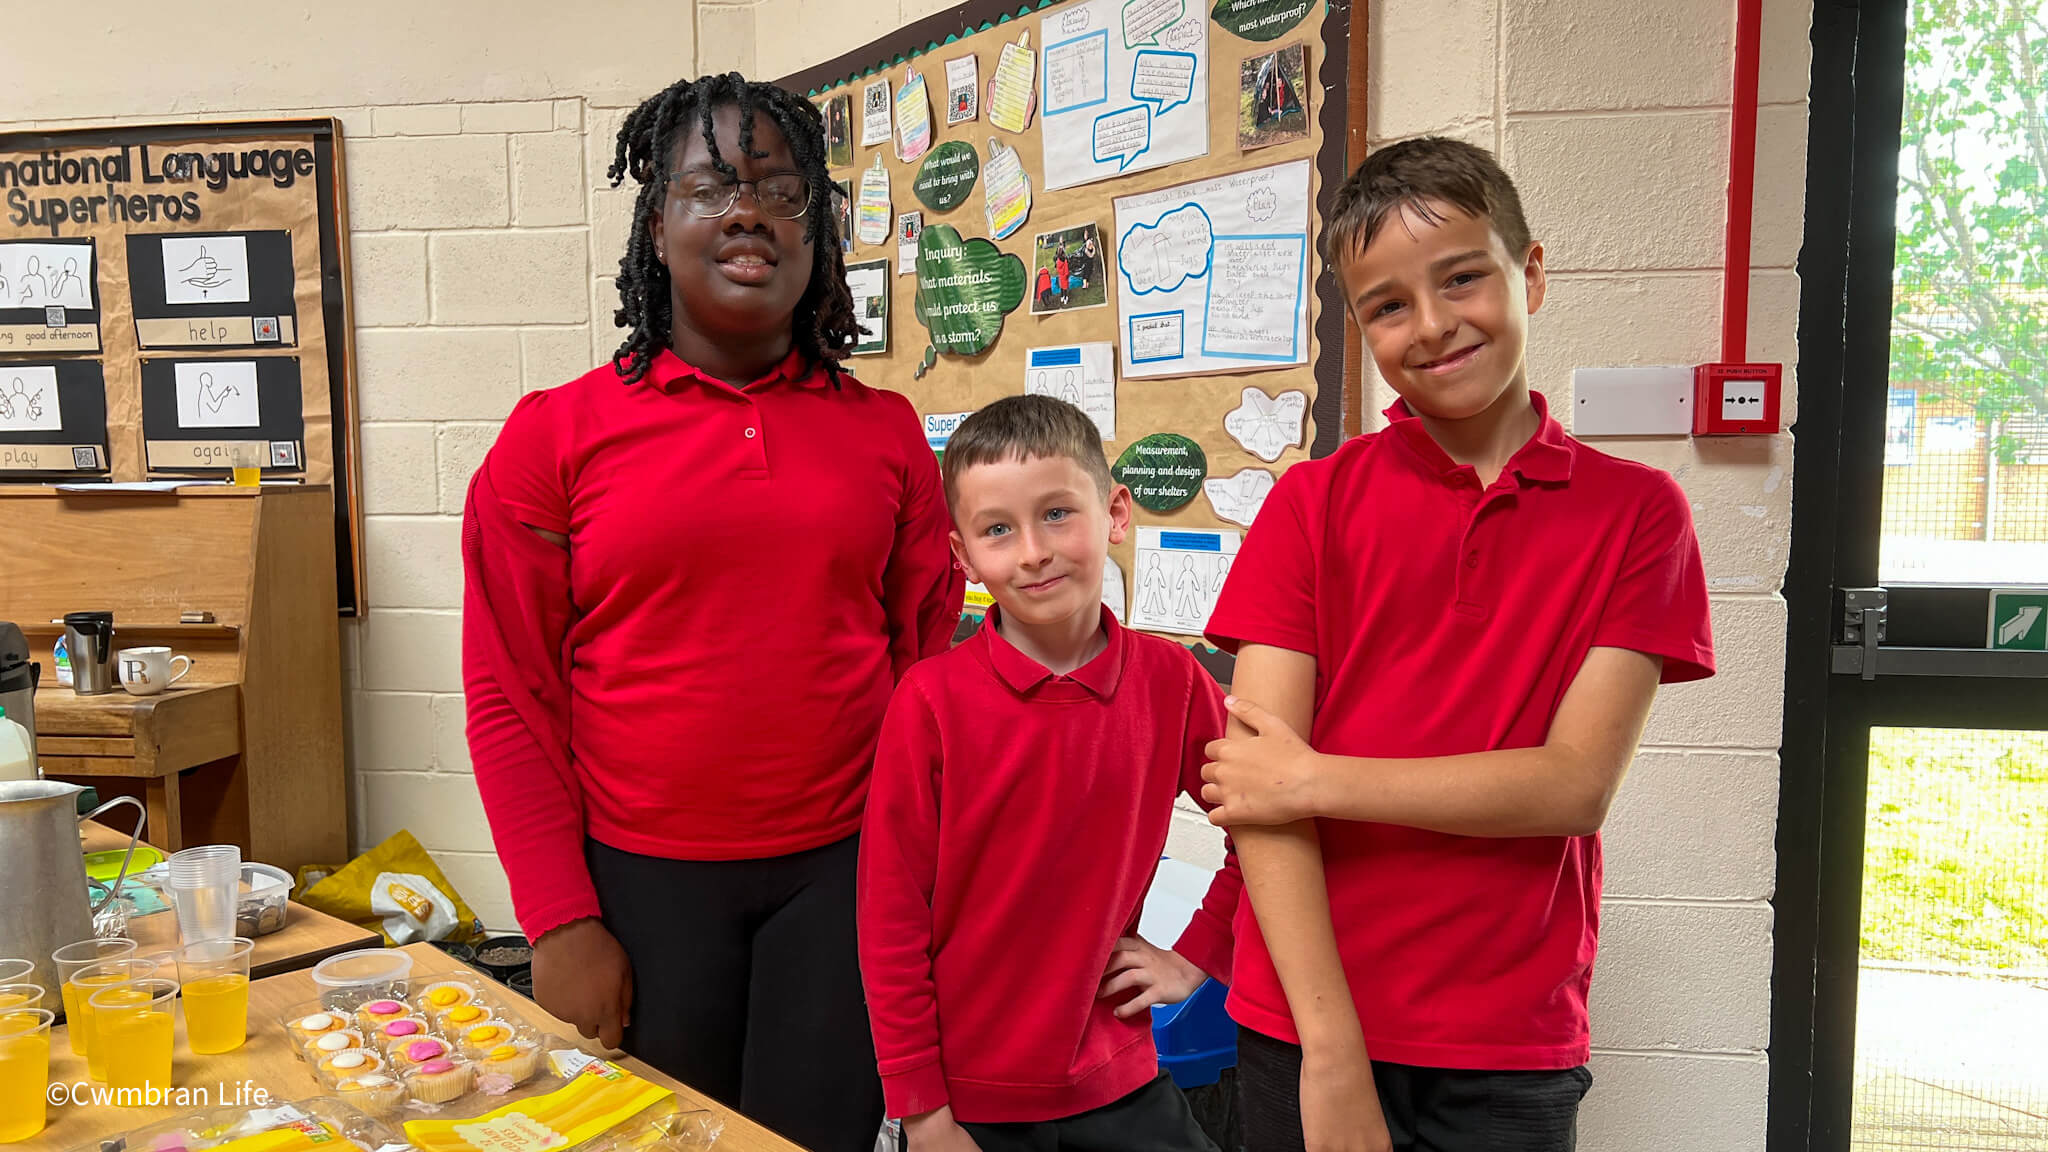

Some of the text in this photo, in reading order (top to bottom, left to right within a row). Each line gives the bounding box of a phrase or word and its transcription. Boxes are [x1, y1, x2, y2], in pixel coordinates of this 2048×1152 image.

[1239, 3, 1307, 32] most waterproof?
[940, 153, 960, 166] would
[961, 152, 971, 161] we
[140, 145, 314, 192] Language
[933, 177, 940, 187] to
[941, 175, 958, 185] bring
[960, 169, 975, 180] with
[939, 193, 951, 204] us?
[8, 185, 201, 236] Superheros
[924, 245, 967, 264] Inquiry:
[938, 269, 992, 288] materials
[943, 302, 978, 320] protect
[983, 302, 997, 312] us
[25, 330, 46, 345] good
[50, 329, 93, 340] afternoon
[189, 321, 228, 342] help
[948, 329, 981, 343] storm?
[927, 416, 957, 435] Super
[4, 447, 38, 468] play
[1135, 445, 1188, 456] Measurement,
[1122, 464, 1201, 479] planning and design
[1134, 484, 1188, 498] of our shelters
[123, 660, 151, 685] R
